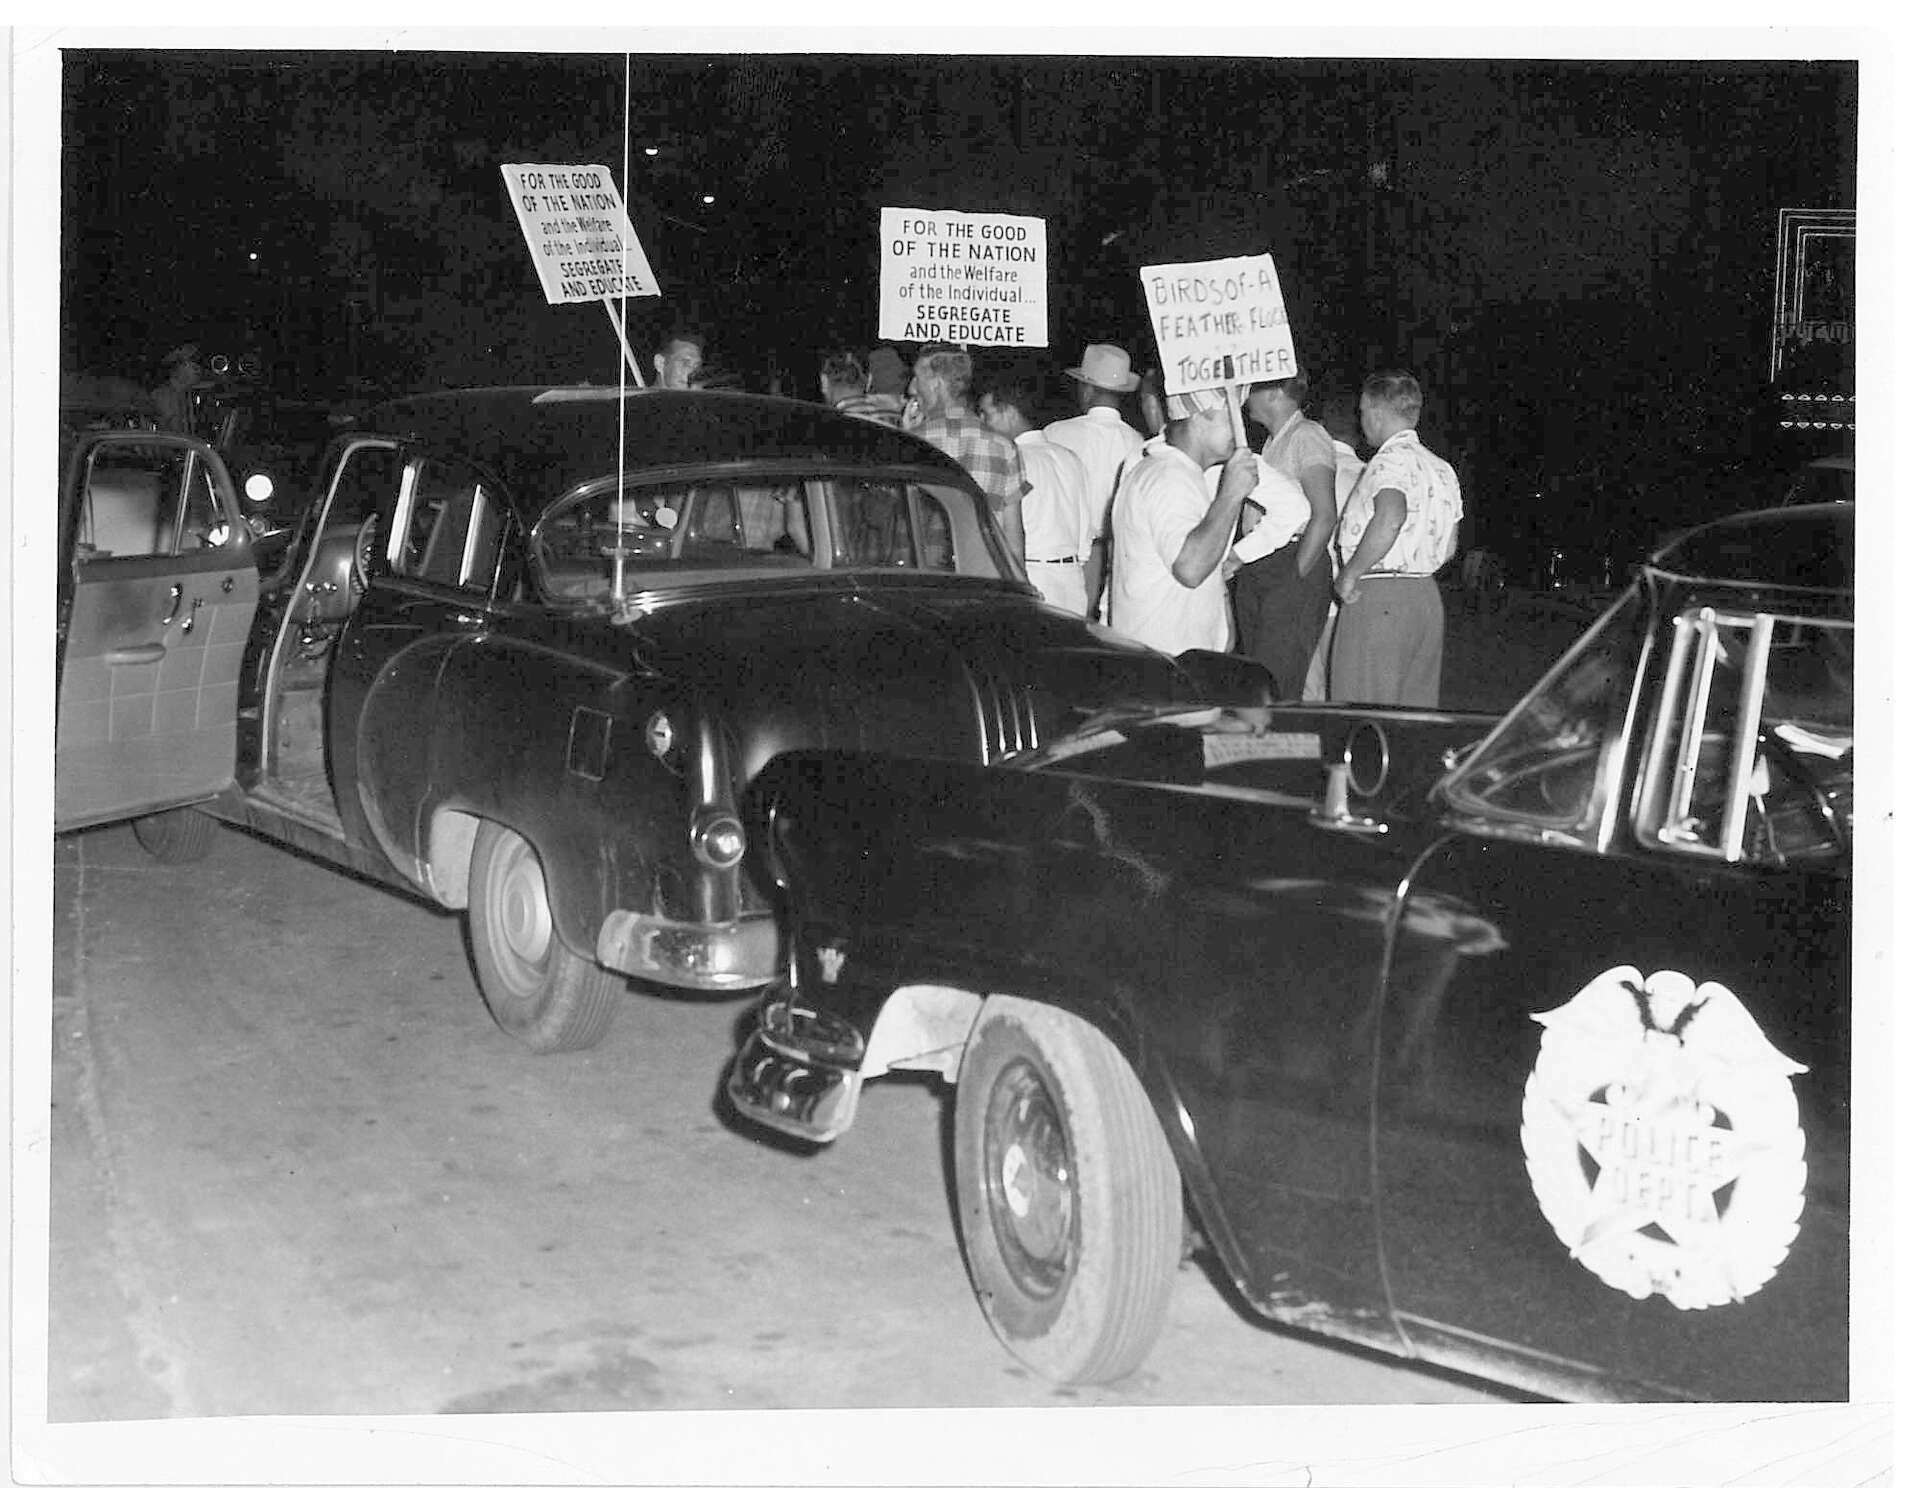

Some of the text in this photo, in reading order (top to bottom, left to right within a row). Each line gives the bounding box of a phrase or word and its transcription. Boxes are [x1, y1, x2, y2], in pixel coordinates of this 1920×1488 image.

[520, 173, 601, 190] FOR THE GOOD
[522, 193, 617, 212] OF THE NATION
[541, 217, 614, 235] and the Welfare
[903, 219, 1026, 241] FOR THE GOOD
[555, 239, 573, 255] the
[892, 239, 1036, 262] OF THE NATION
[560, 259, 623, 278] SEGREGATE
[910, 263, 1018, 282] and the Welfare
[561, 280, 587, 298] AND
[899, 283, 915, 298] of
[919, 284, 943, 299] the
[917, 304, 1011, 323] SEGREGATE
[904, 323, 1025, 342] AND EDUCATE
[1597, 1116, 1723, 1177] POLICE
